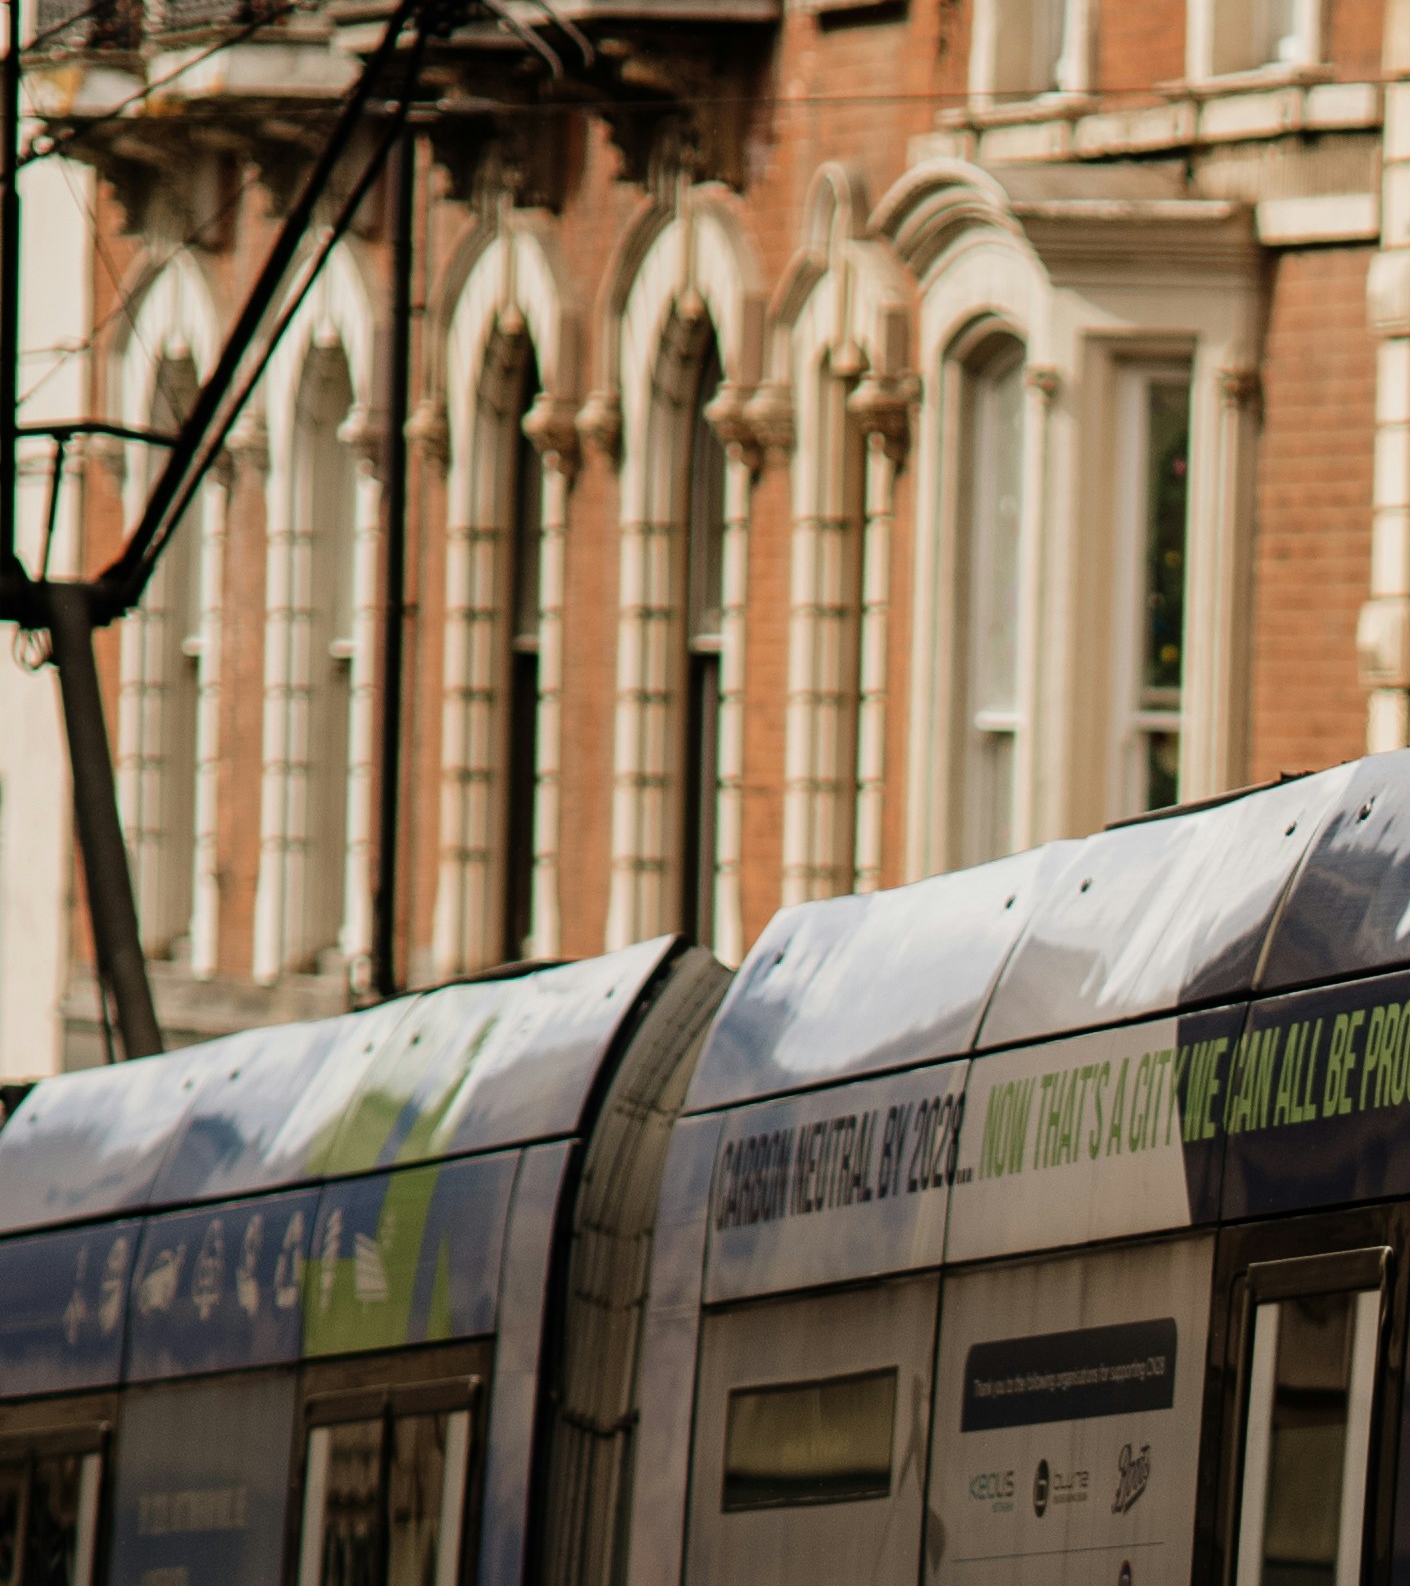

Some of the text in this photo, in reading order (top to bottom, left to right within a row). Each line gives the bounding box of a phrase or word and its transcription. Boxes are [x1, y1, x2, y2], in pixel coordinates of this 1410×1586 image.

[790, 1110, 877, 1216] NEUTRAL
[877, 1102, 913, 1199] BY
[978, 1078, 1036, 1180] NOW
[1033, 1060, 1111, 1169] THAT'S
[1106, 1058, 1130, 1156] A
[1128, 1047, 1188, 1152] CITY
[1183, 1038, 1228, 1143] WE
[1223, 1028, 1281, 1135] CAN
[1273, 1018, 1324, 1126] ALL
[1322, 1010, 1365, 1117] BE
